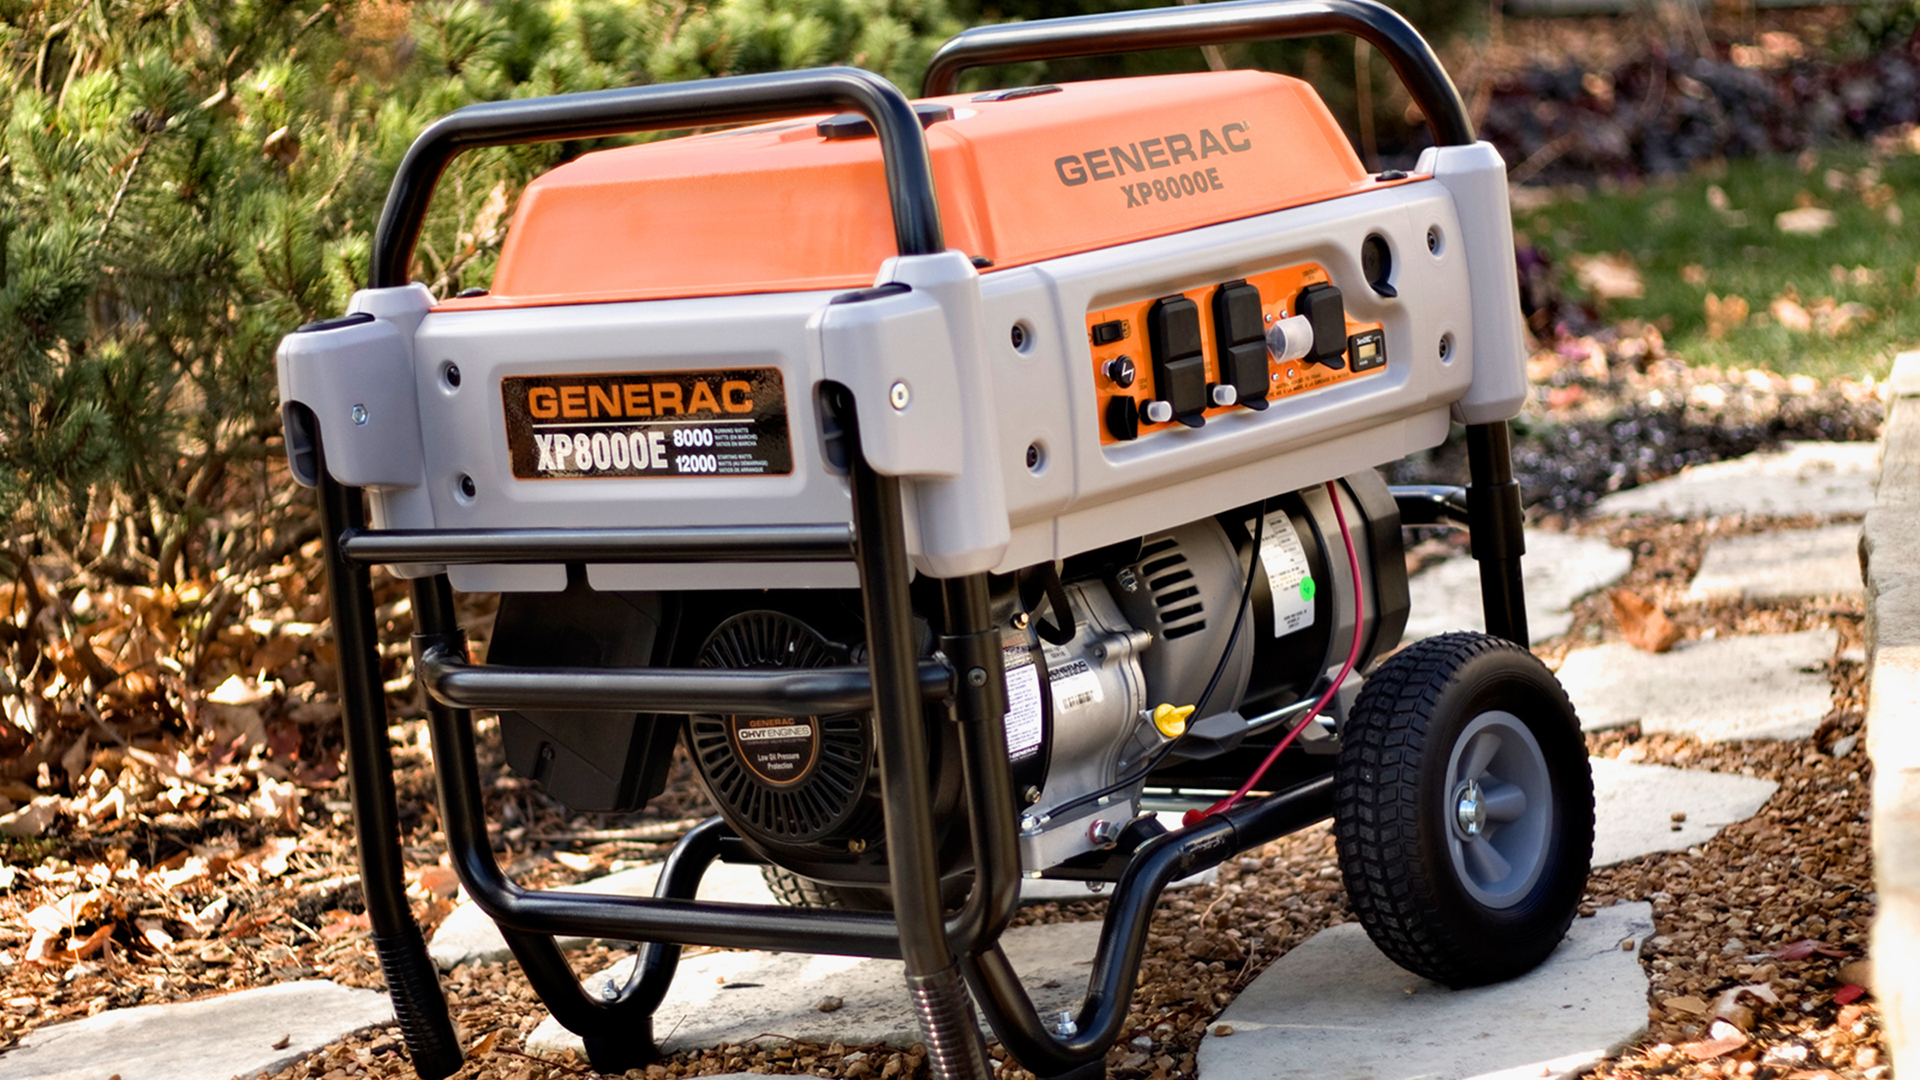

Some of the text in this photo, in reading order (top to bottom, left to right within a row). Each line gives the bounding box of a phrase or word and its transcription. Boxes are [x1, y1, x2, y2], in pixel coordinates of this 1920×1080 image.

[1054, 122, 1251, 187] GENERAC
[1120, 167, 1224, 209] XP8000E
[528, 380, 753, 418] GENERAC
[673, 428, 713, 447] 8000
[534, 431, 668, 471] XP8000E
[675, 454, 717, 473] 12000
[749, 718, 795, 728] GENERAC
[767, 726, 810, 737] ENGINES
[767, 762, 794, 770] Protection
